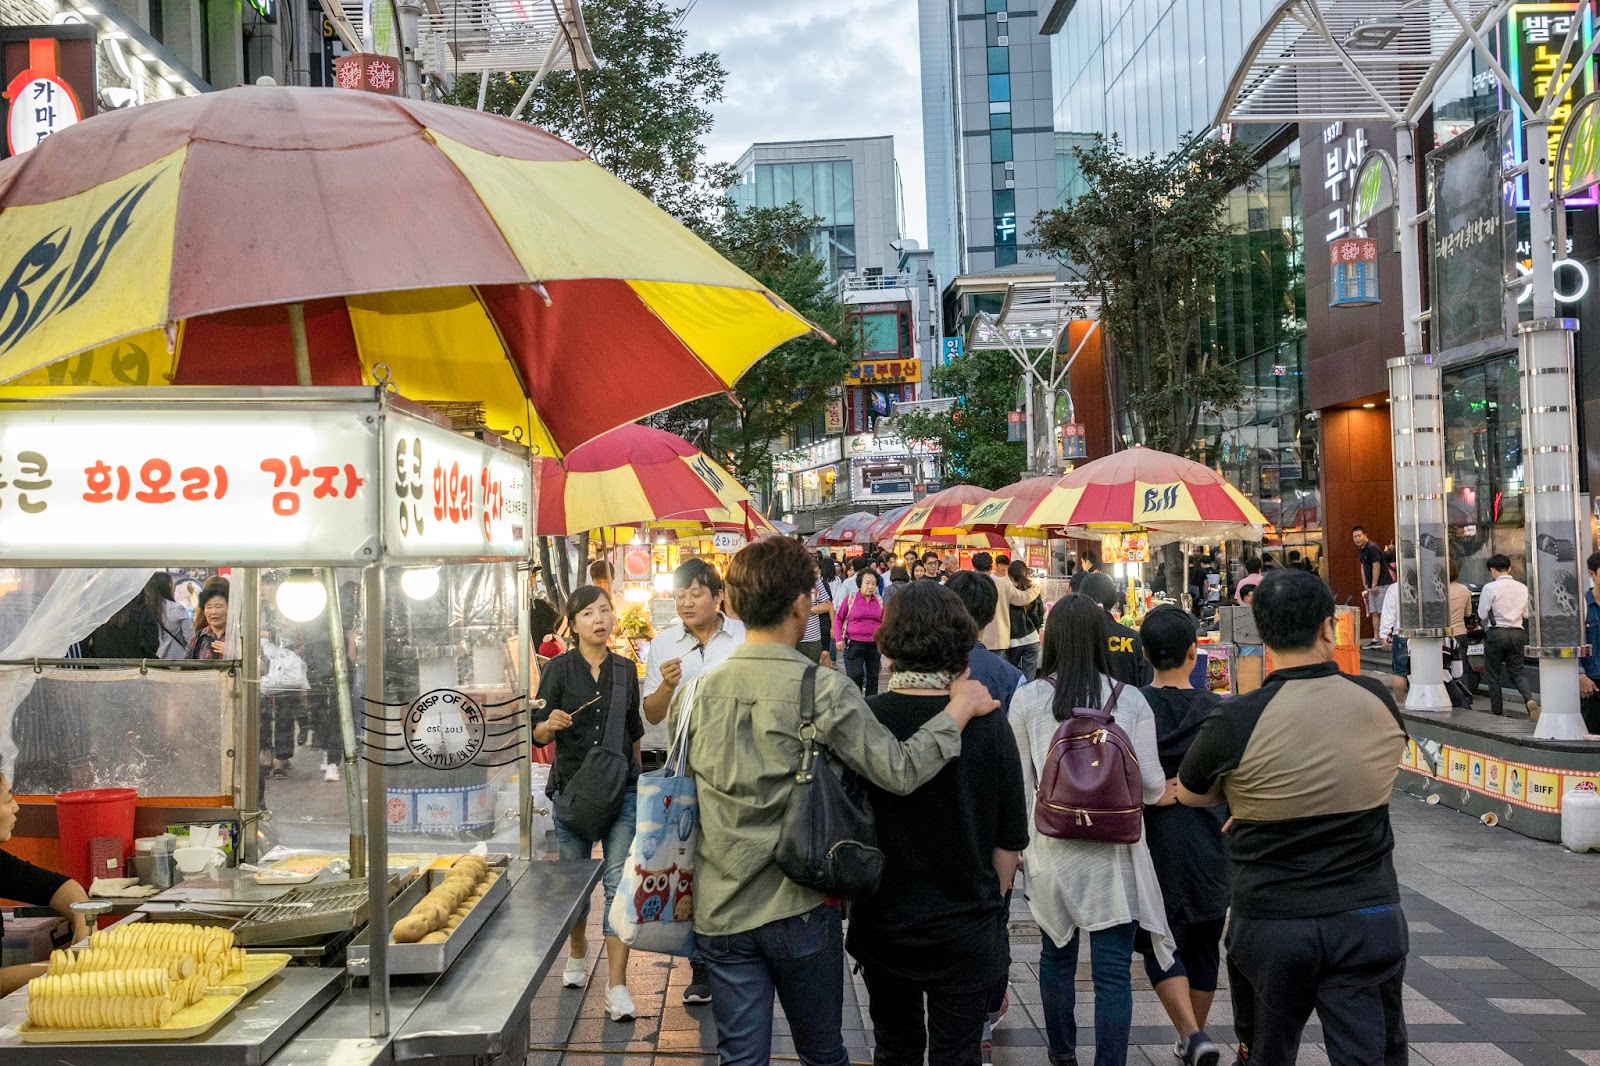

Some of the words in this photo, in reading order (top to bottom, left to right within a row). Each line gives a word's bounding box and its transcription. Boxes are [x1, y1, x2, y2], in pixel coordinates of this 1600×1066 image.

[1324, 121, 1342, 144] 1937
[0, 450, 52, 514] 큰
[82, 455, 228, 504] 회오리
[260, 455, 365, 516] 감자
[432, 458, 473, 524] 회오리
[481, 465, 504, 542] 감자
[1454, 762, 1467, 772] BIFF
[1534, 784, 1555, 795] BIFF
